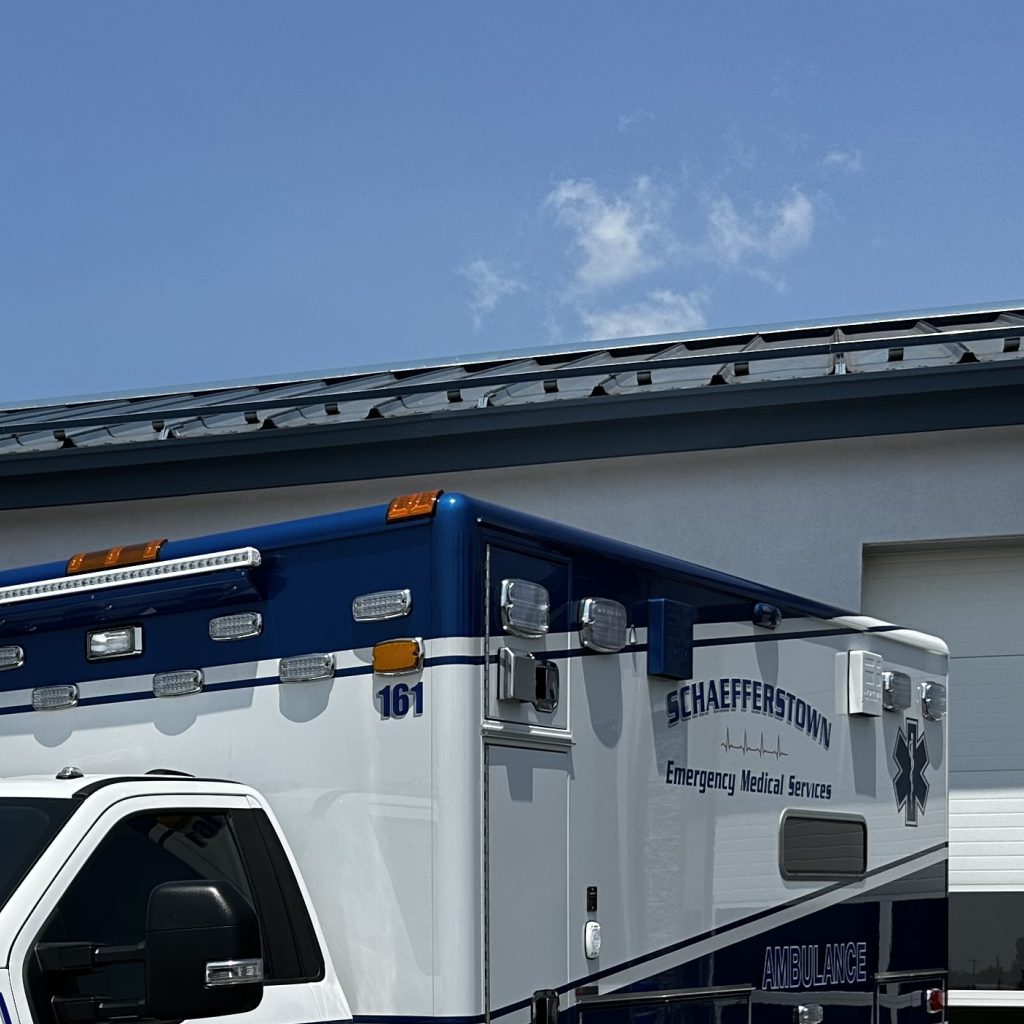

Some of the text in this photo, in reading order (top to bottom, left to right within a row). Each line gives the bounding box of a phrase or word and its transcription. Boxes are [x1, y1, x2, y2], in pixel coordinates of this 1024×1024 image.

[376, 682, 423, 720] 161
[666, 678, 832, 751] SCHAEFFERSTOWN
[666, 760, 832, 800] Emergency Medical Services
[762, 942, 867, 990] AMBULANCE
